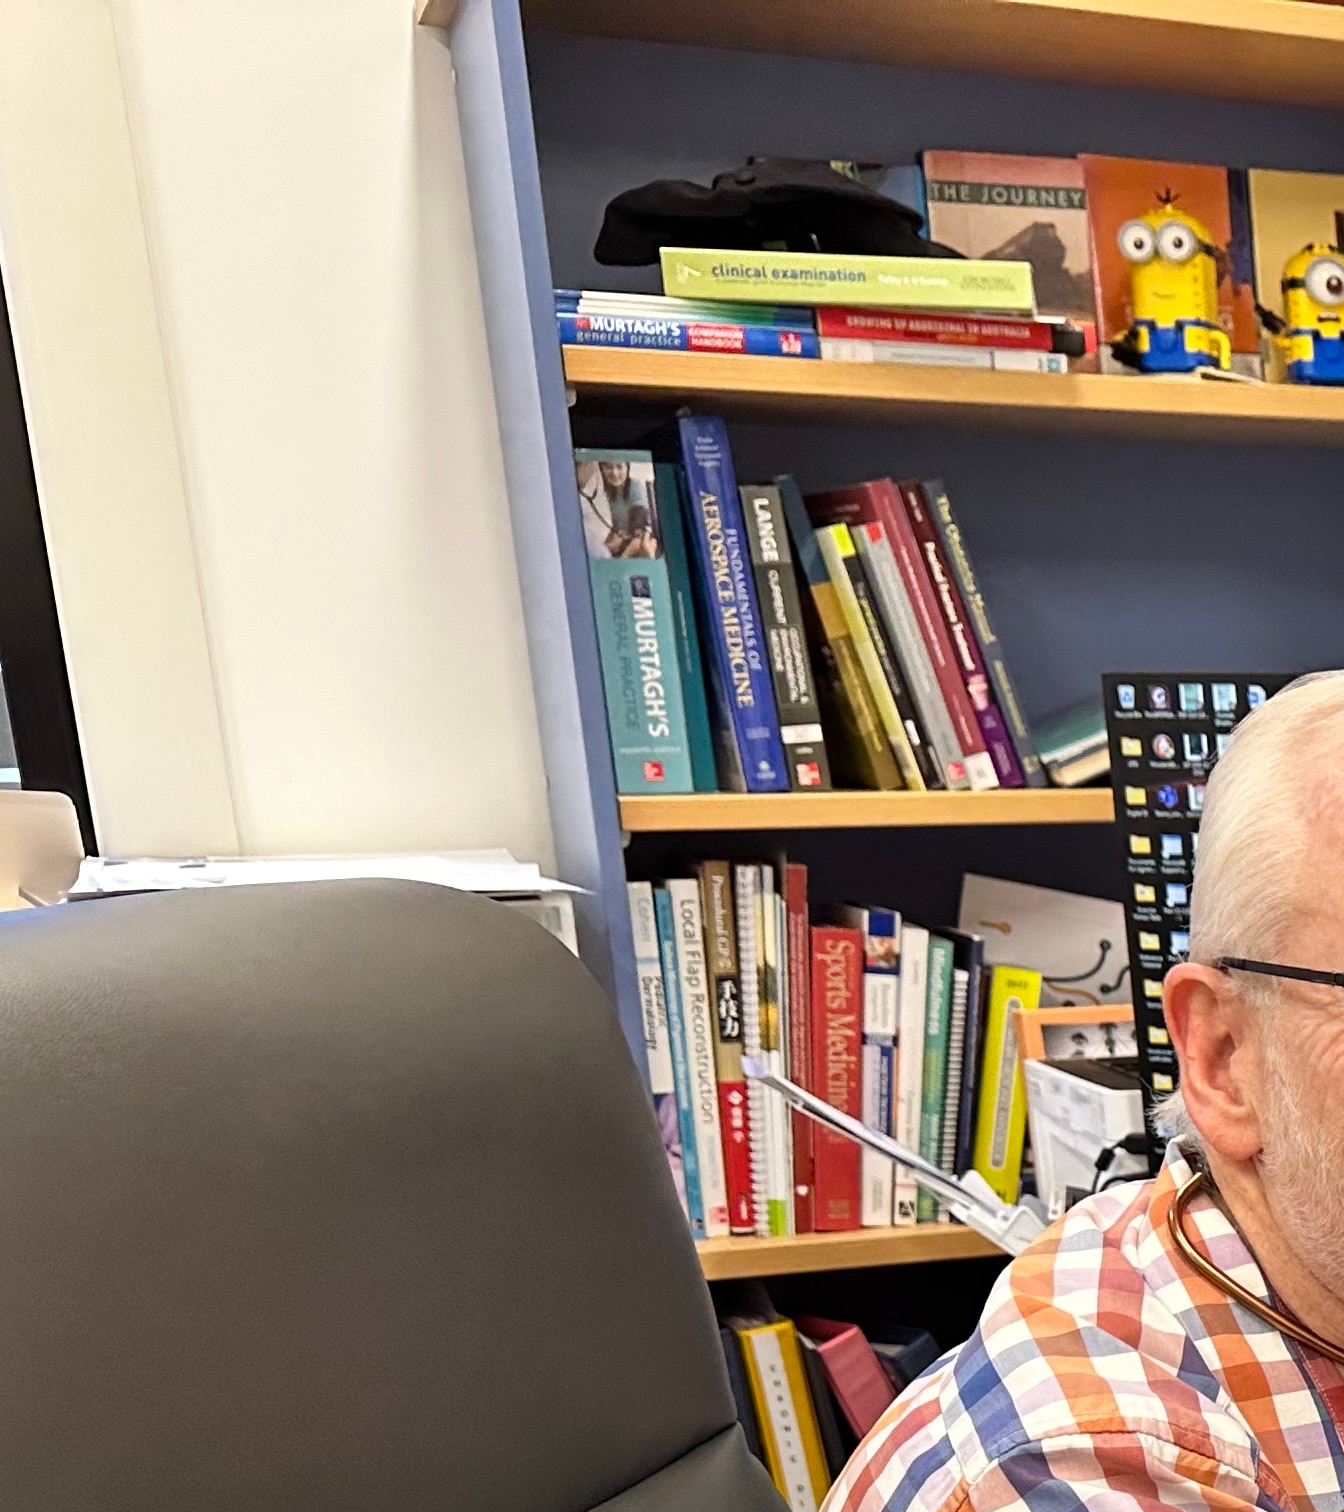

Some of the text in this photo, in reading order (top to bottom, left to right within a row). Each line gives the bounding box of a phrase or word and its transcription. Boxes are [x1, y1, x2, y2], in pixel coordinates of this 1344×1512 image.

[932, 183, 1082, 206] THE JOURNEY
[712, 263, 767, 278] clinical
[772, 265, 866, 282] examination
[576, 330, 681, 346] general practice
[589, 317, 681, 336] MURTAGH'S
[754, 498, 778, 562] LANGE
[701, 490, 754, 708] AEROSPACE MEDICINE
[609, 580, 641, 731] GENERAL PRACTICE
[631, 598, 670, 737] MURTAGH'S
[817, 938, 856, 1011] Sports
[679, 898, 715, 1123] Local Flap Reconstruction
